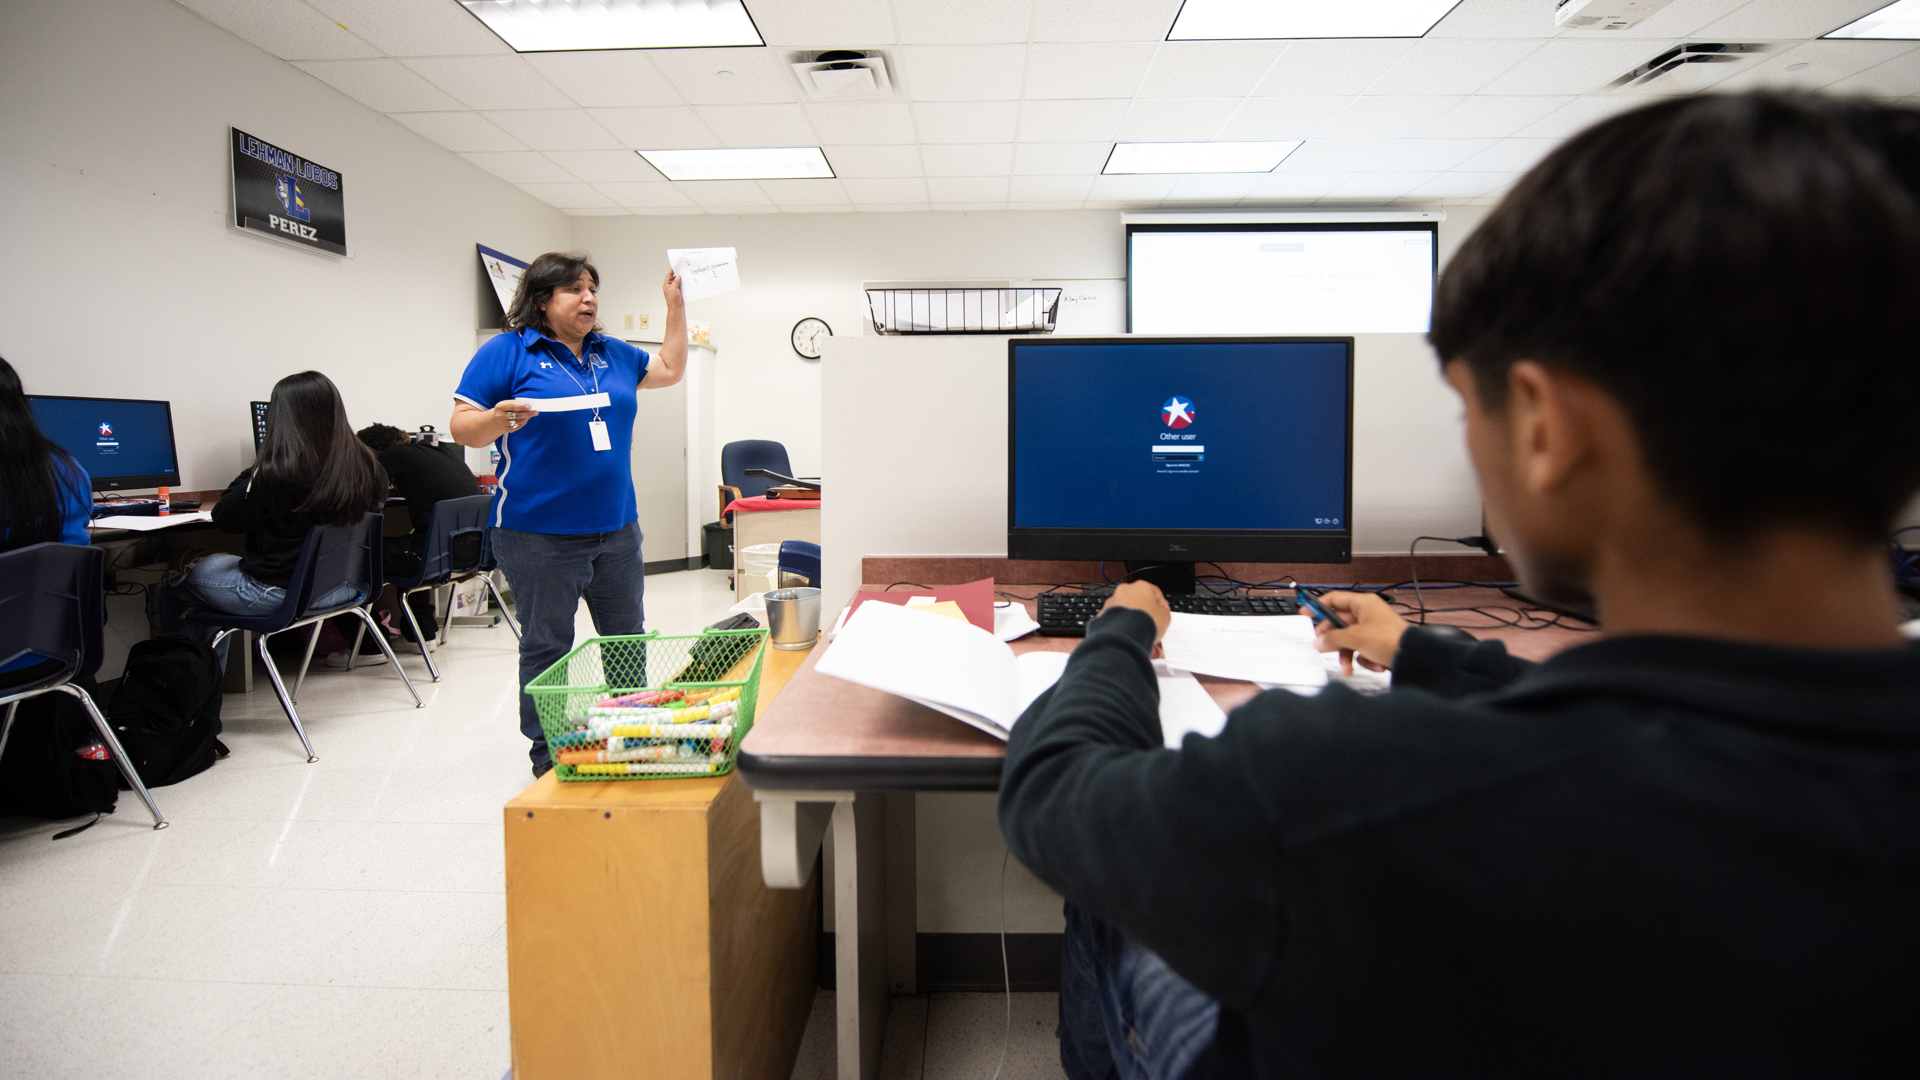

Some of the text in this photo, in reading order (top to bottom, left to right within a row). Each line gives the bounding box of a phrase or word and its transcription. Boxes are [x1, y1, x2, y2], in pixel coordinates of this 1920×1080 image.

[240, 133, 337, 190] LEHMAN LOBOS
[269, 213, 318, 242] PEREZ
[1328, 271, 1354, 280] really
